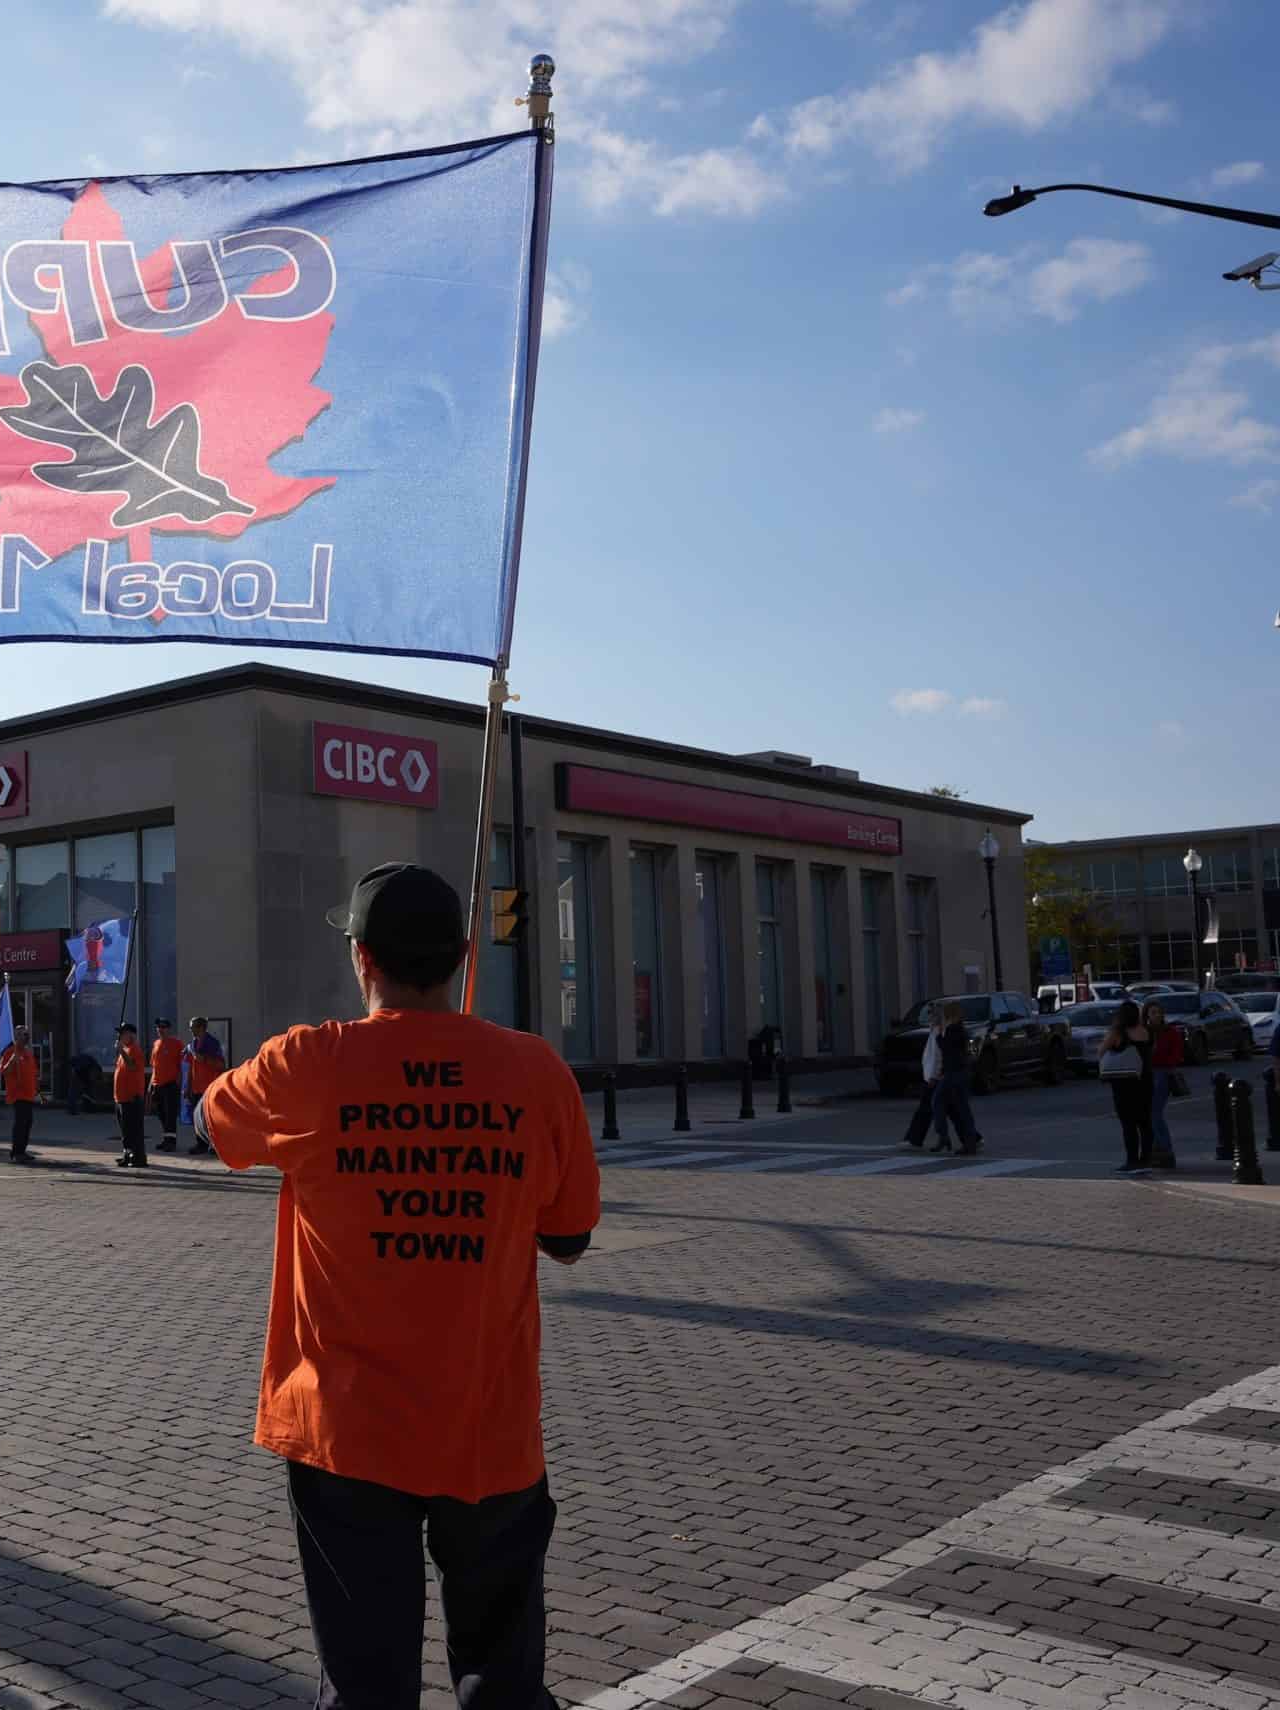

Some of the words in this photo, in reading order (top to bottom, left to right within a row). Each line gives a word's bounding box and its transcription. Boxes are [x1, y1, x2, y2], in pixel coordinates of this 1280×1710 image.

[323, 738, 397, 787] CIBC
[4, 946, 38, 963] Centre
[402, 1060, 463, 1087] WE
[339, 1102, 524, 1133] PROUDLY
[336, 1146, 524, 1180] MAINTAIN
[375, 1188, 486, 1219] YOUR
[368, 1231, 485, 1264] TOWN
